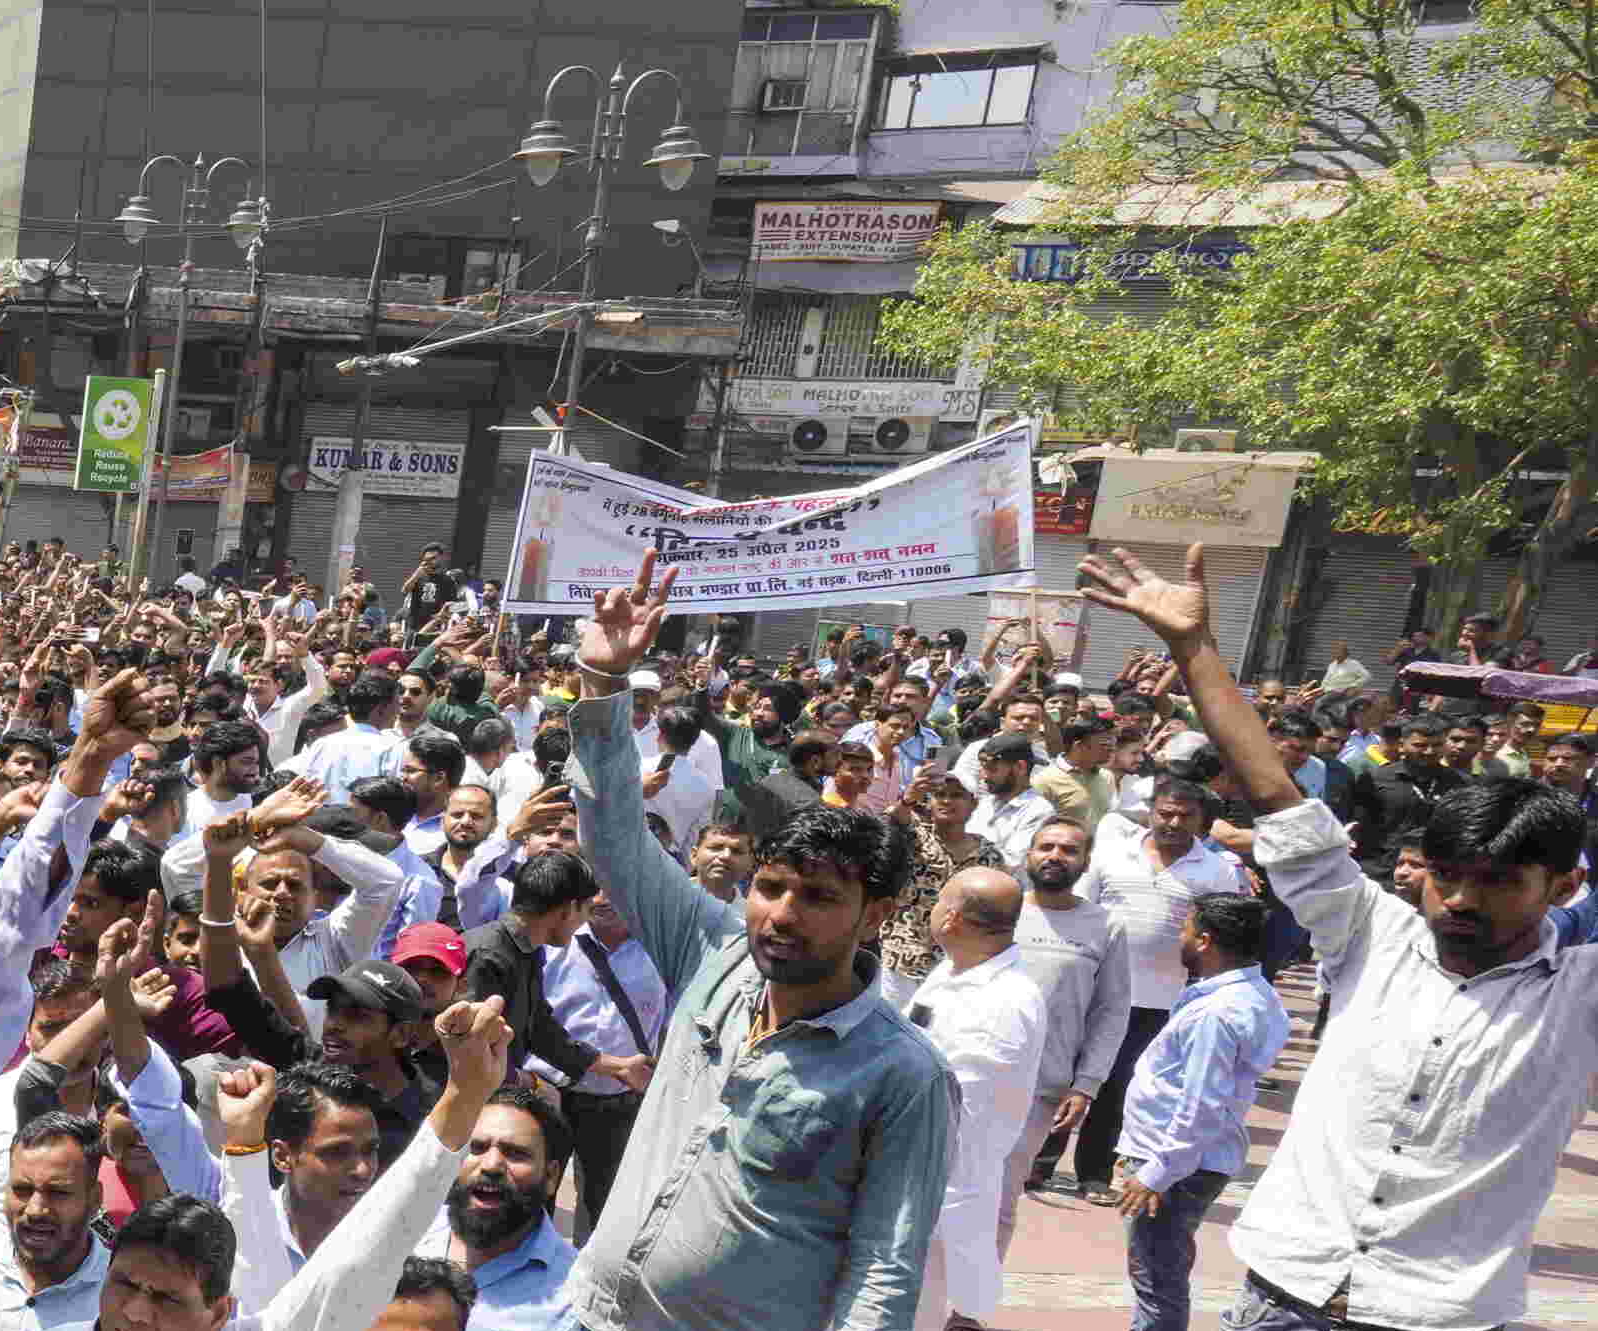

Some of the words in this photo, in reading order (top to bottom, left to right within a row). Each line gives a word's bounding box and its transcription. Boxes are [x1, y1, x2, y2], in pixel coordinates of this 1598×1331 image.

[794, 231, 894, 243] EXTENSION
[388, 450, 403, 472] &
[407, 453, 459, 474] SONS
[795, 536, 842, 552] 2025
